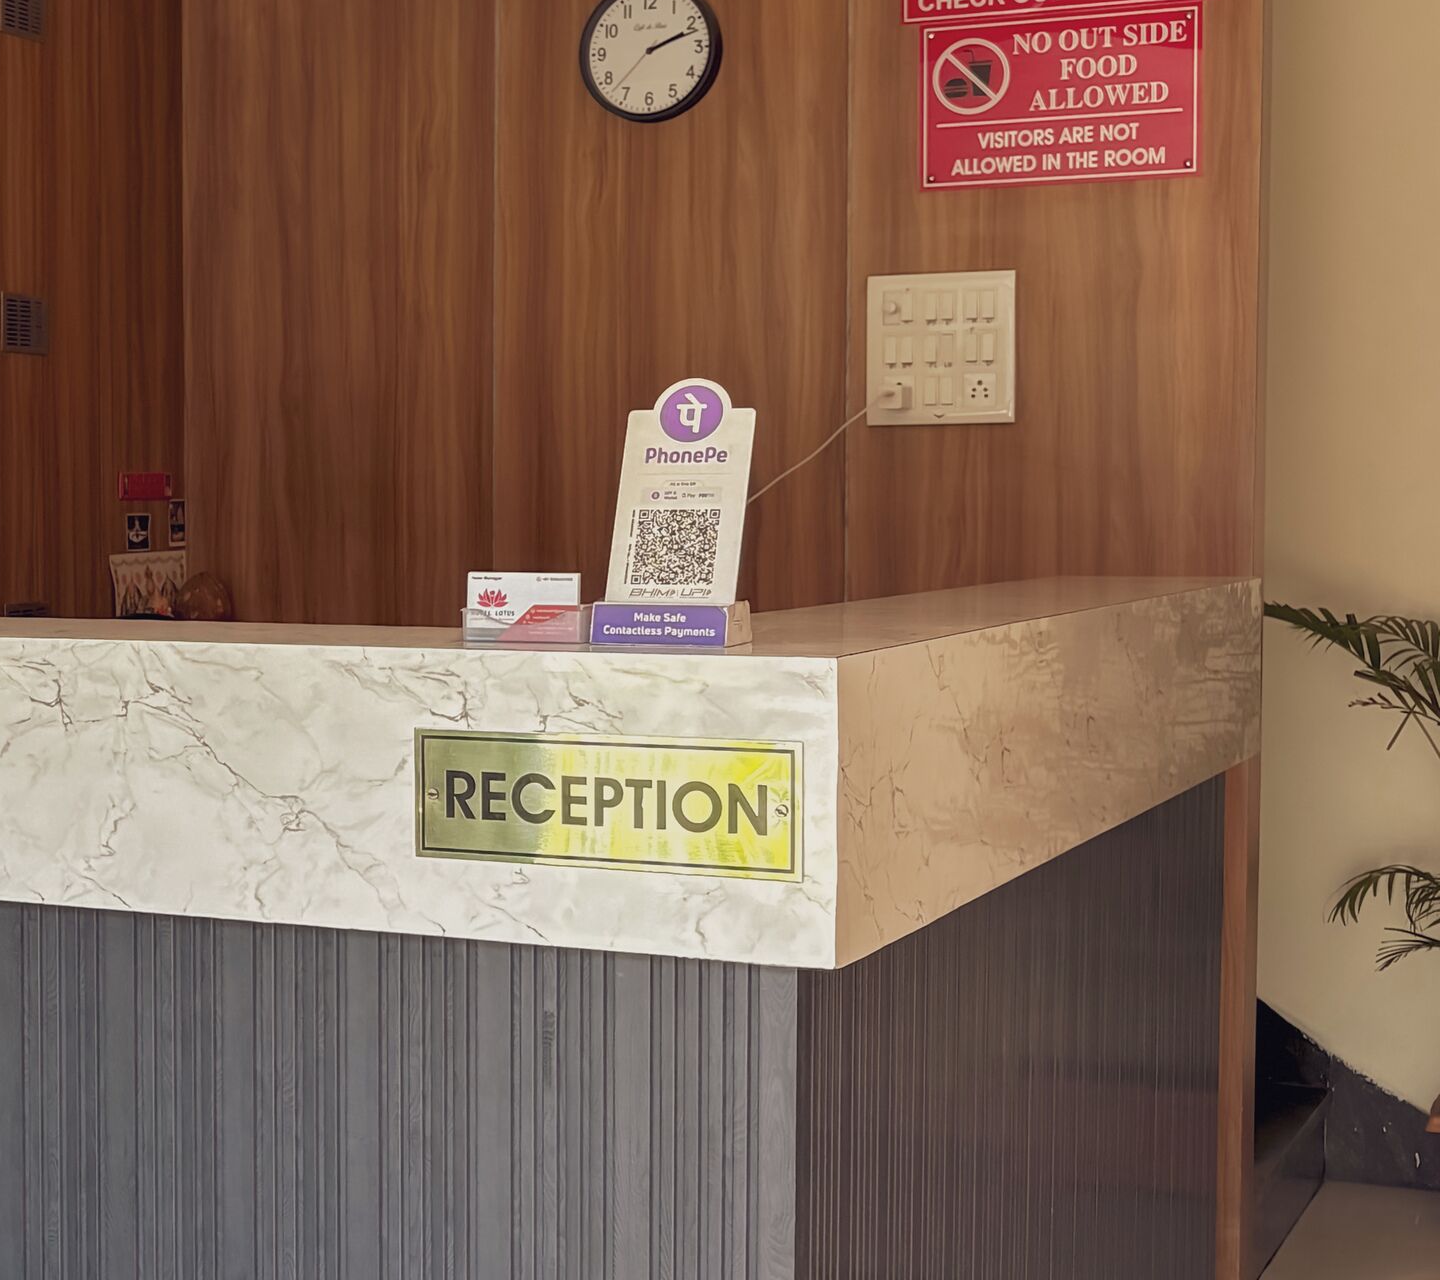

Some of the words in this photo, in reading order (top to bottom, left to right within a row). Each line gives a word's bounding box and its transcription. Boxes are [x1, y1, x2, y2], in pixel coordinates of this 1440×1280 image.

[623, 4, 632, 19] 11
[686, 15, 696, 31] 2
[605, 23, 618, 39] 10
[1012, 31, 1052, 55] NO
[1058, 25, 1117, 52] OUT
[1122, 19, 1188, 47] SIDE
[694, 39, 703, 54] 3
[597, 47, 606, 62] 9
[686, 65, 695, 79] 4
[1060, 53, 1138, 81] FOOD
[604, 71, 613, 86] 8
[622, 86, 630, 101] 7
[668, 83, 678, 98] 5
[1029, 81, 1169, 112] ALLOWED
[644, 91, 654, 106] 6
[977, 128, 1054, 150] VISITORS
[1059, 125, 1094, 145] ARE
[1099, 122, 1139, 142] NOT
[951, 154, 1037, 177] ALLOWED
[1042, 153, 1060, 171] IN
[1066, 150, 1098, 169] THE
[1104, 146, 1165, 167] ROOM
[645, 446, 728, 464] PhonePe
[633, 612, 661, 622] Make
[663, 613, 687, 623] Safe
[603, 625, 662, 635] Contactless
[664, 626, 716, 637] Payments
[446, 769, 767, 836] RECEPTION
